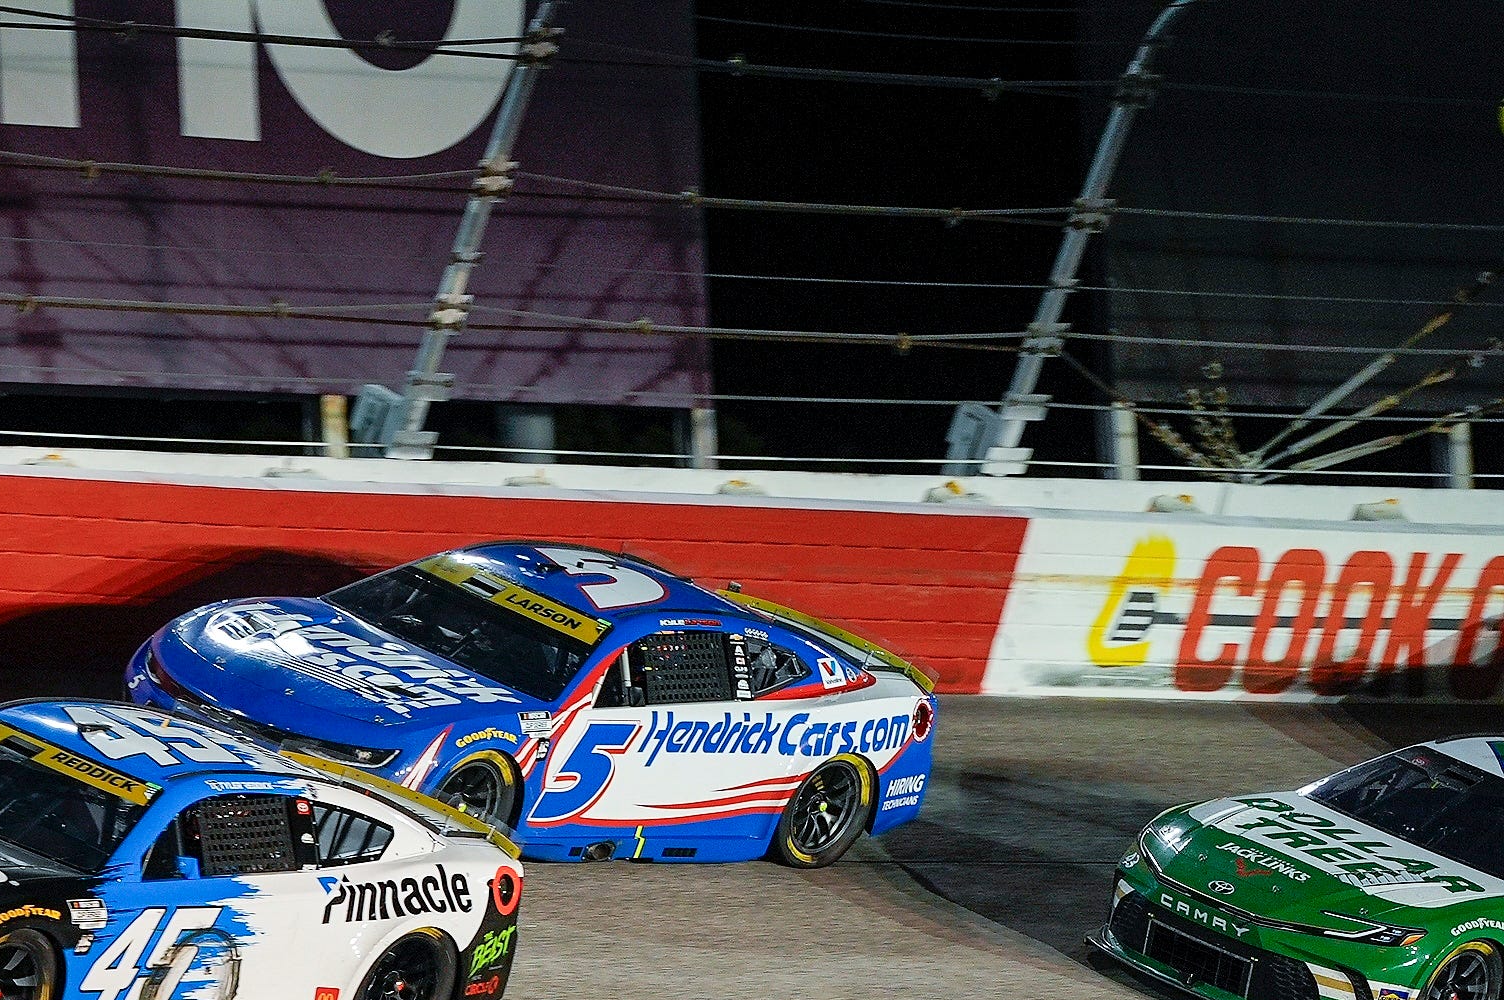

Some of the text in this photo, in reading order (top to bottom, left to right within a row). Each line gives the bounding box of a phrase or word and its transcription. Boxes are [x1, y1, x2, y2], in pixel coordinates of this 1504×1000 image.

[535, 547, 665, 609] 5
[505, 594, 583, 630] LARSON
[128, 674, 146, 689] 5
[62, 706, 245, 767] 45
[455, 727, 518, 748] GOODYEAR
[50, 751, 140, 793] REDDICK
[527, 722, 640, 821] 5
[886, 773, 926, 798] HIRING
[882, 795, 920, 811] TECHNICIANS
[1215, 841, 1264, 863] JACK
[1231, 797, 1486, 894] DOLLAR
[1237, 816, 1398, 878] TREE
[316, 863, 473, 925] Pinnacle
[1159, 892, 1251, 938] CAMRY
[467, 925, 517, 979] BEAST
